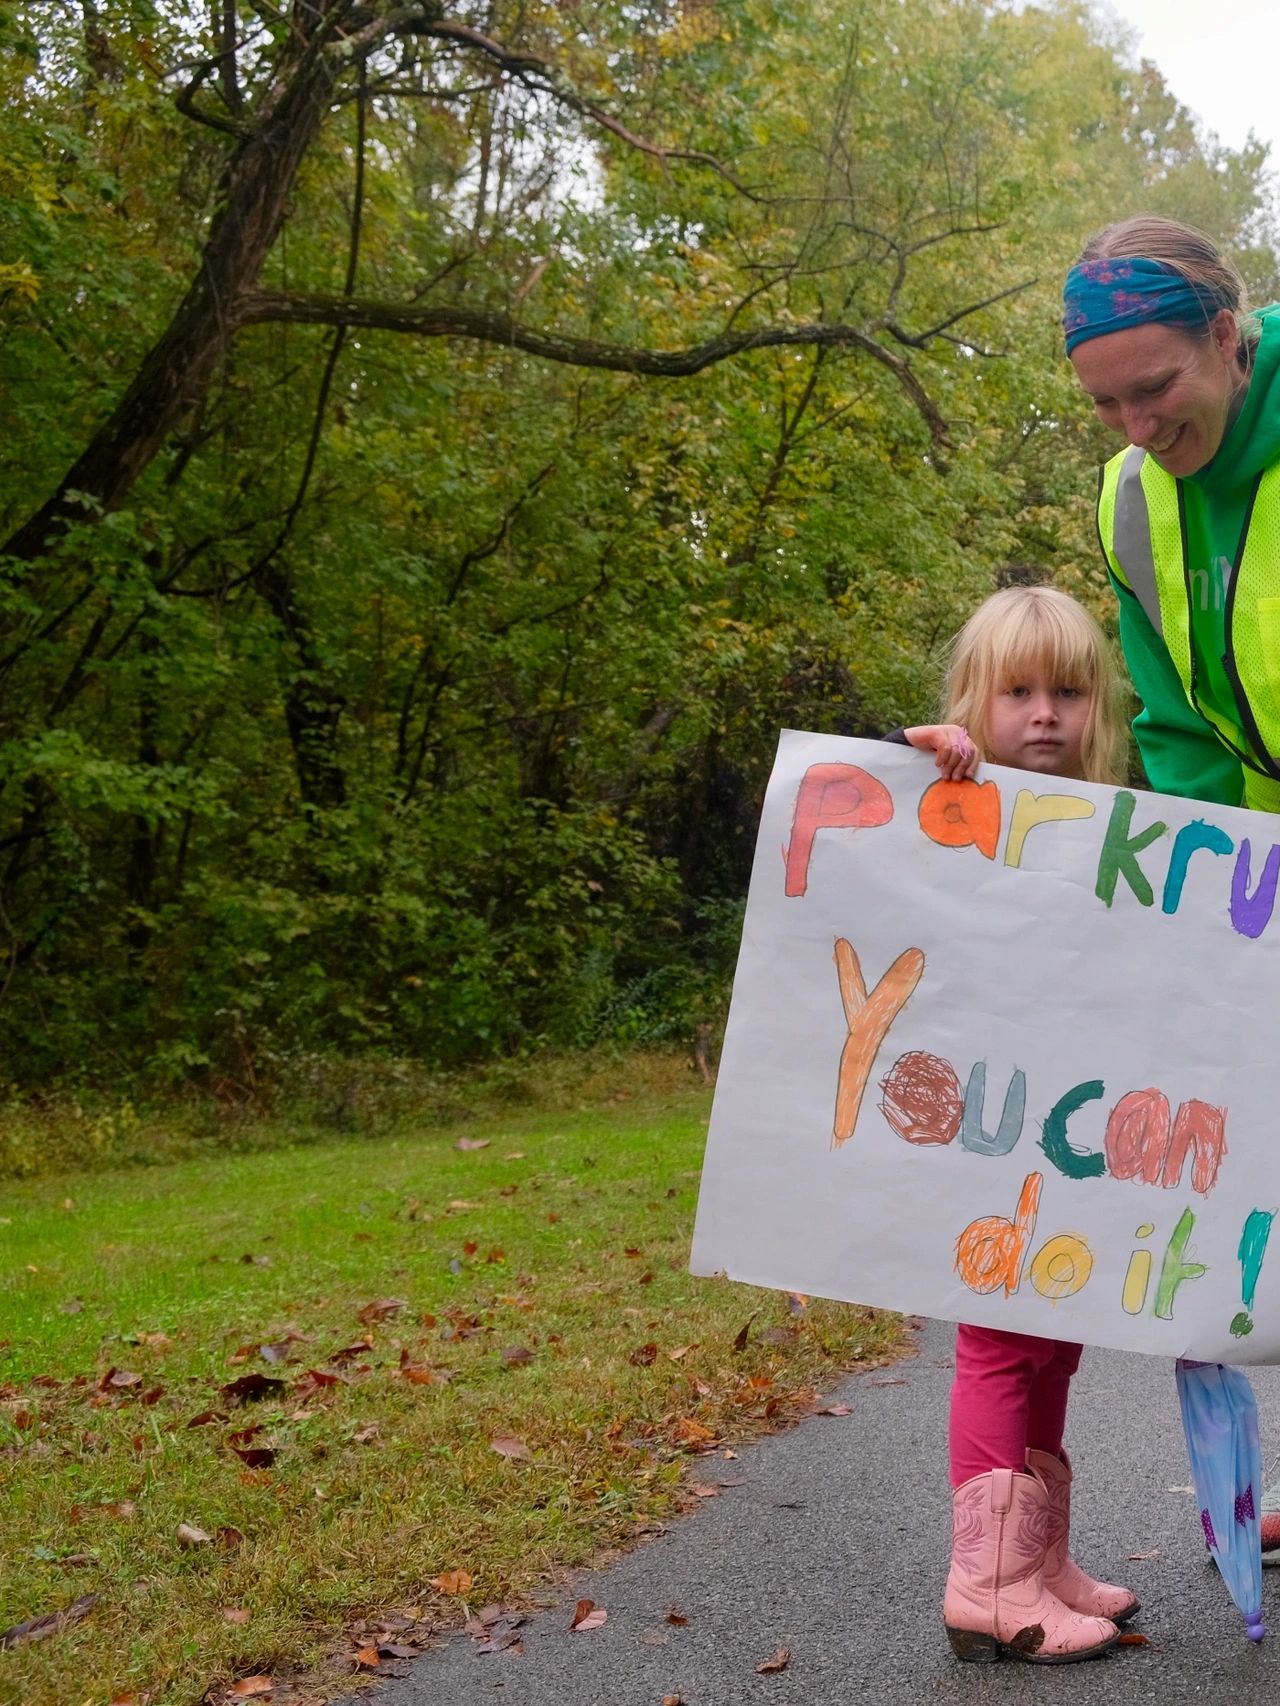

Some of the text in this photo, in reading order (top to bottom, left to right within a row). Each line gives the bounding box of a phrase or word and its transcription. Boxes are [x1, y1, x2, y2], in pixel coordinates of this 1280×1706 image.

[829, 936, 1228, 1198] You can
[953, 1171, 1094, 1303] do
